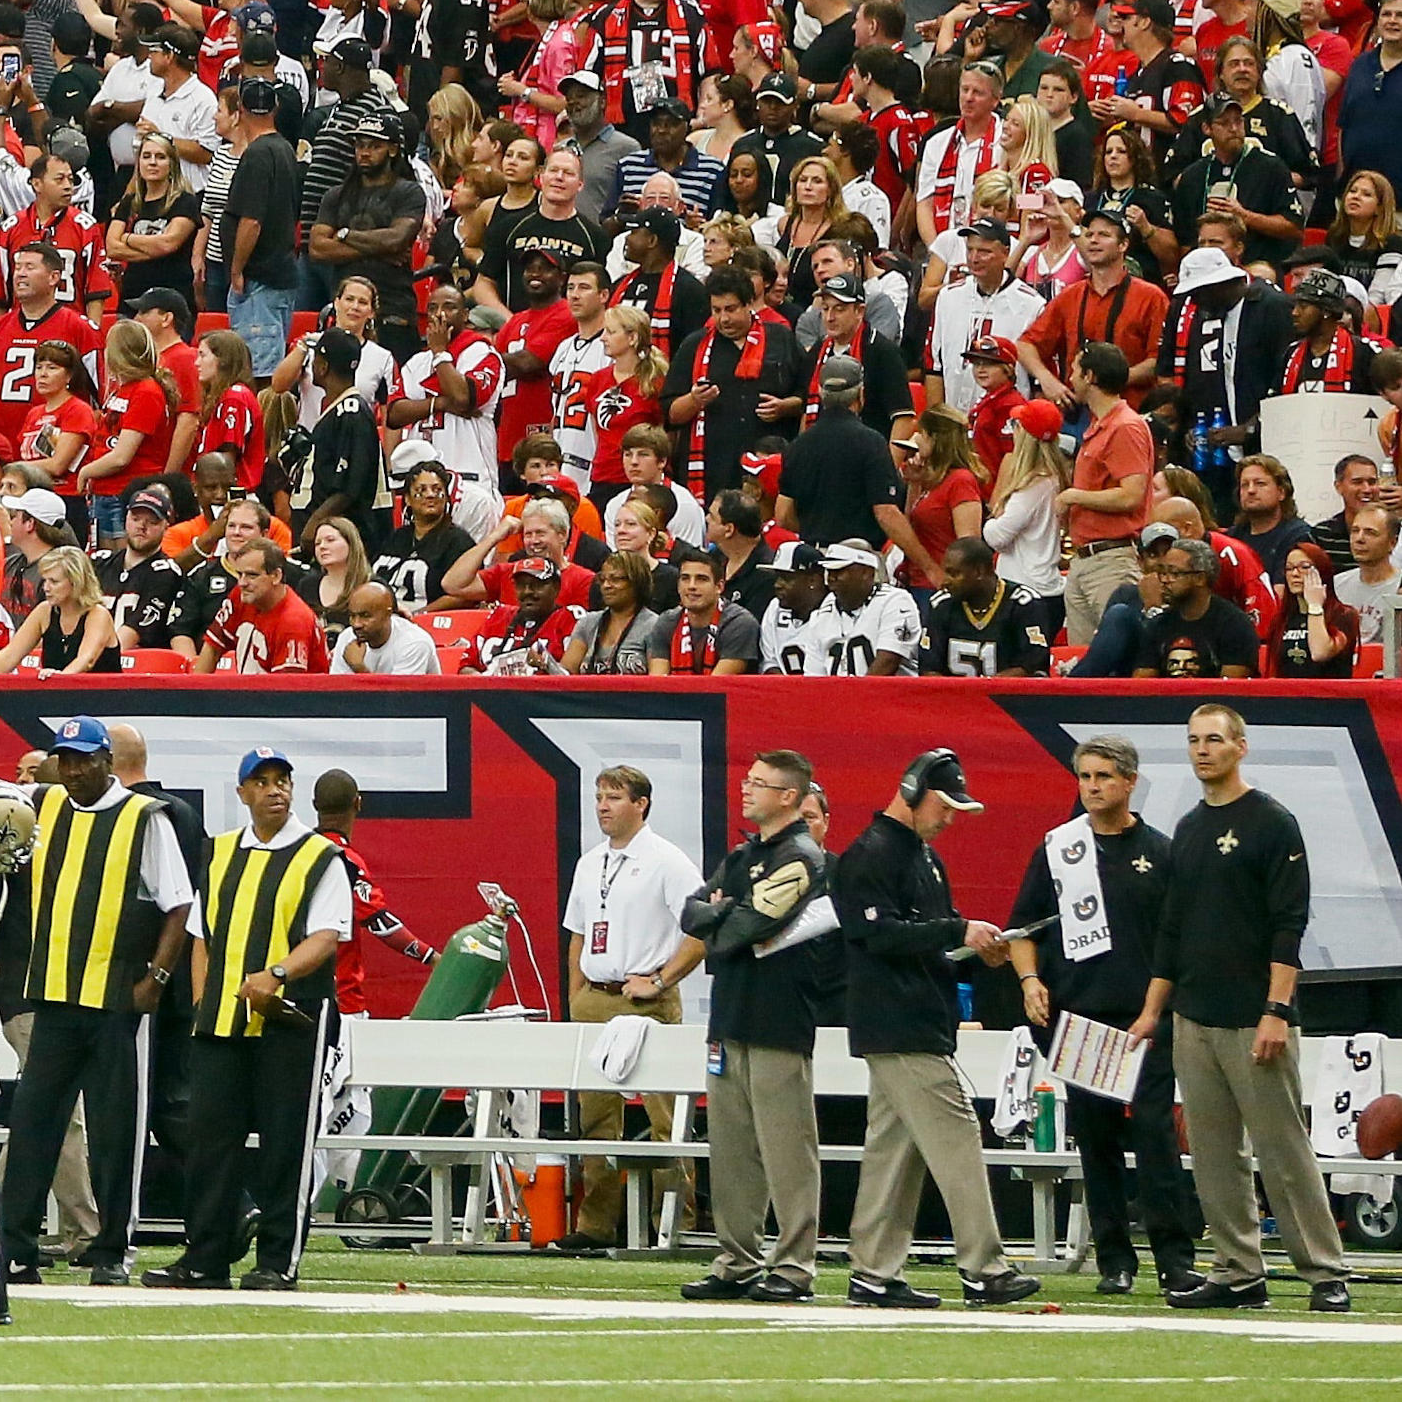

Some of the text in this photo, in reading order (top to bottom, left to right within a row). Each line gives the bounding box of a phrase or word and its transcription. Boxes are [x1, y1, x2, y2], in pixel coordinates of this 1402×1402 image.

[514, 236, 586, 258] SAINTS
[0, 346, 37, 403] 2
[947, 637, 997, 678] 51
